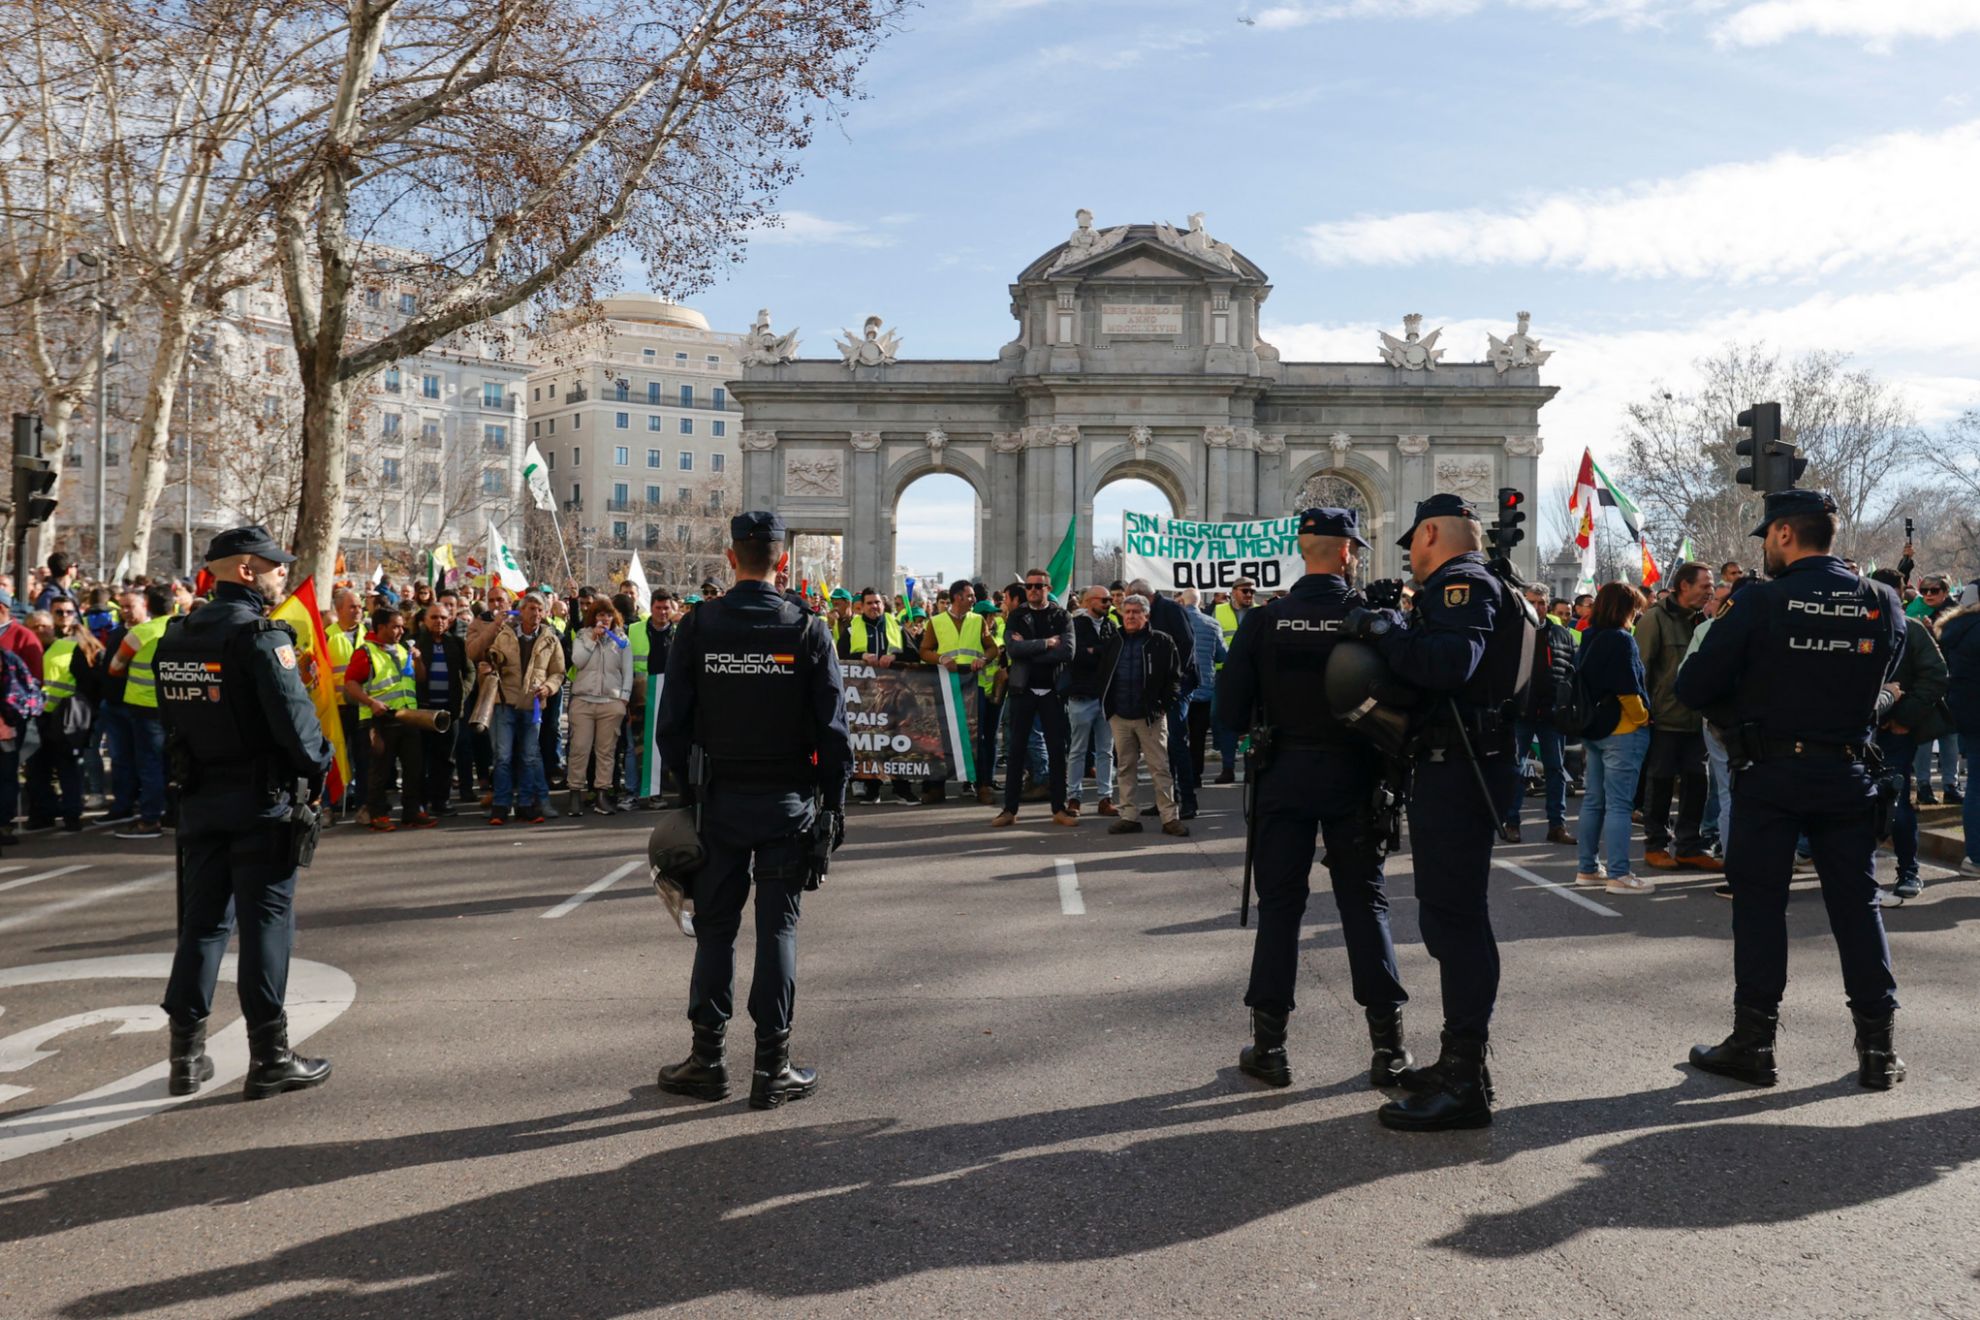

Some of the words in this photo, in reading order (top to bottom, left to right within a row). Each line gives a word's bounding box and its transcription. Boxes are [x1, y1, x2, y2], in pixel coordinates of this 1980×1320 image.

[1126, 511, 1159, 534] SIN
[1167, 515, 1301, 540] AGRICULTUR
[1127, 533, 1156, 557] NO
[1158, 534, 1204, 561] HAY
[1787, 599, 1870, 618] POLICIA
[1276, 619, 1343, 631] POLIC
[1789, 637, 1855, 652] U.I.P.
[704, 653, 776, 663] POLICIA
[159, 661, 207, 672] POLICIA
[705, 664, 794, 674] NACIONAL
[839, 664, 877, 679] ERA
[160, 671, 222, 683] NACIONAL
[163, 686, 207, 701] U.I.P.
[844, 686, 862, 704] A
[850, 733, 912, 753] MPO
[863, 761, 879, 774] LA
[883, 761, 931, 776] SERENA
